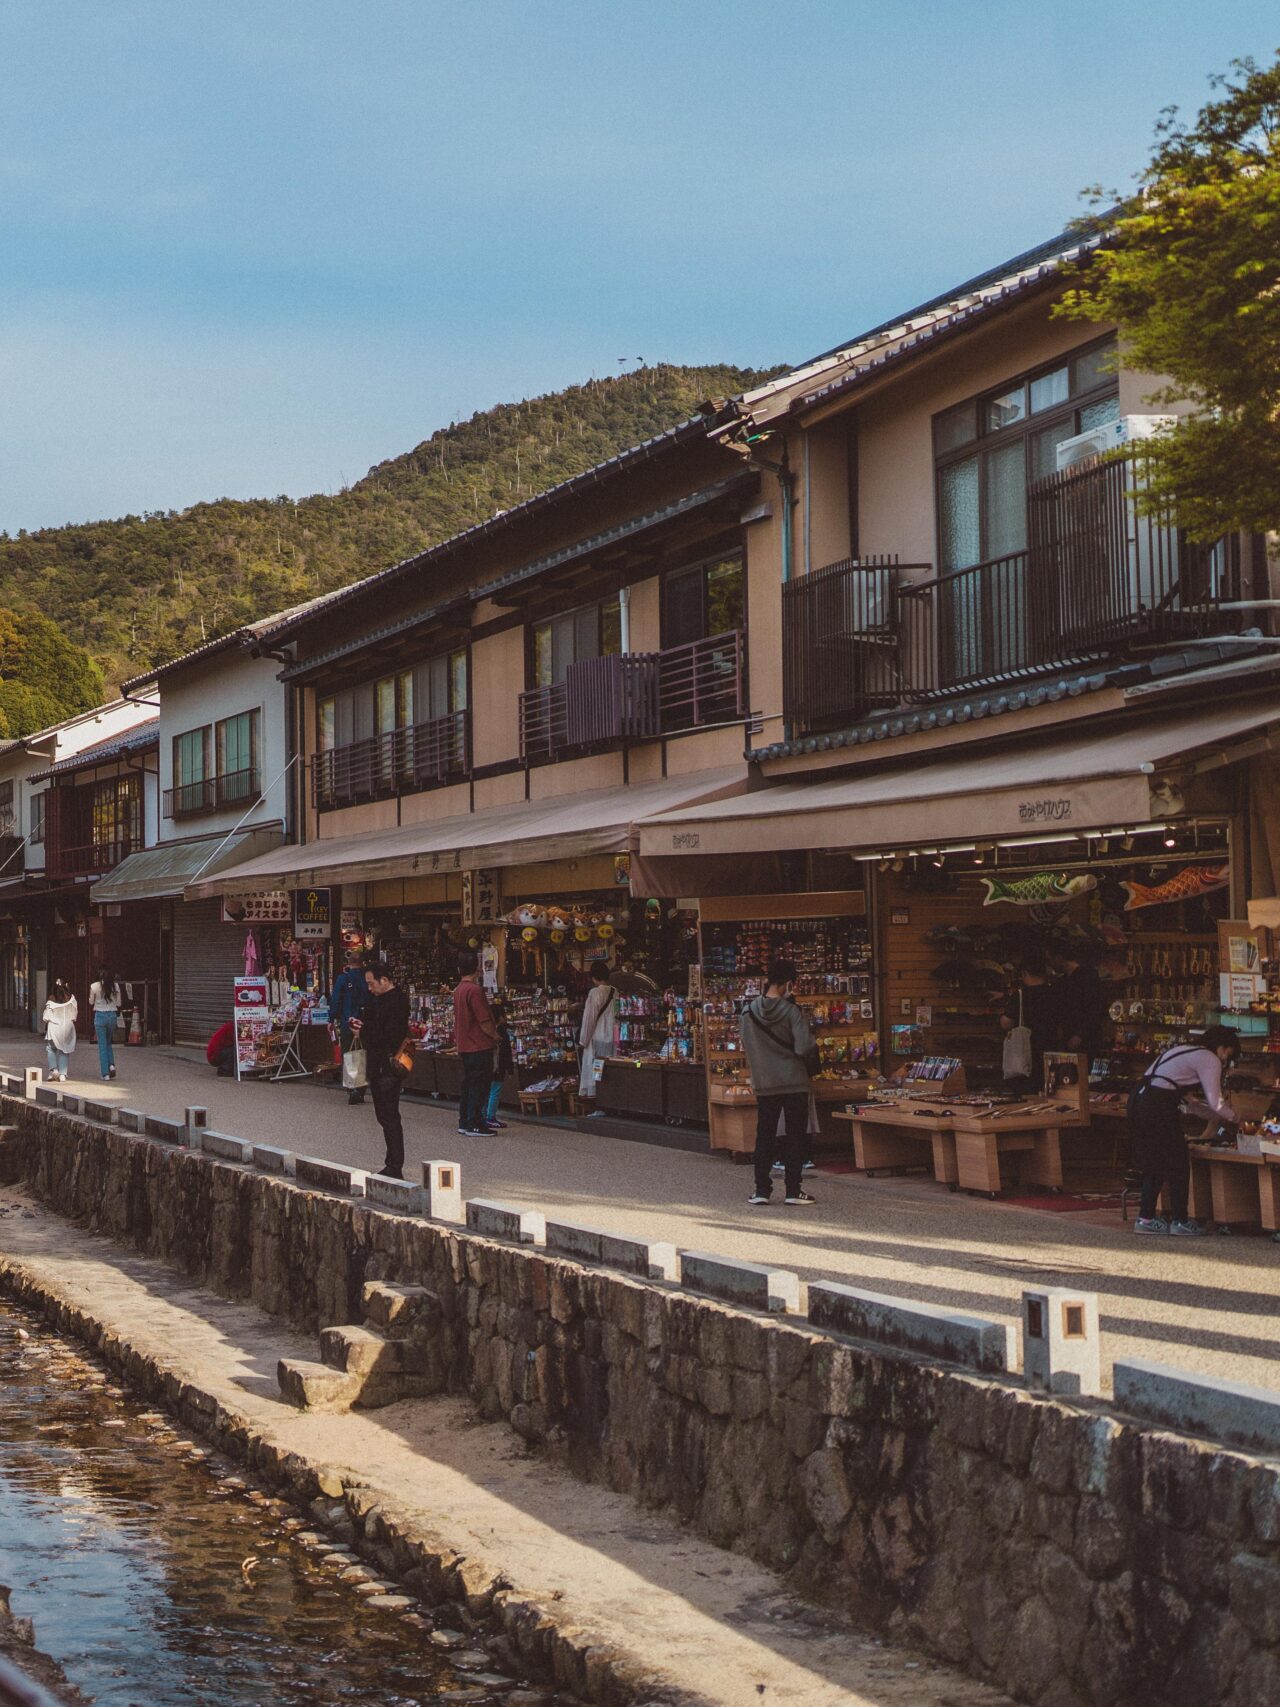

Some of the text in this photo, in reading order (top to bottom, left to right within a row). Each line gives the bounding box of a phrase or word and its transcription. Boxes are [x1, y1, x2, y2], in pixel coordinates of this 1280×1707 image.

[477, 873, 494, 921] 平野屋
[298, 912, 328, 921] COFFEE
